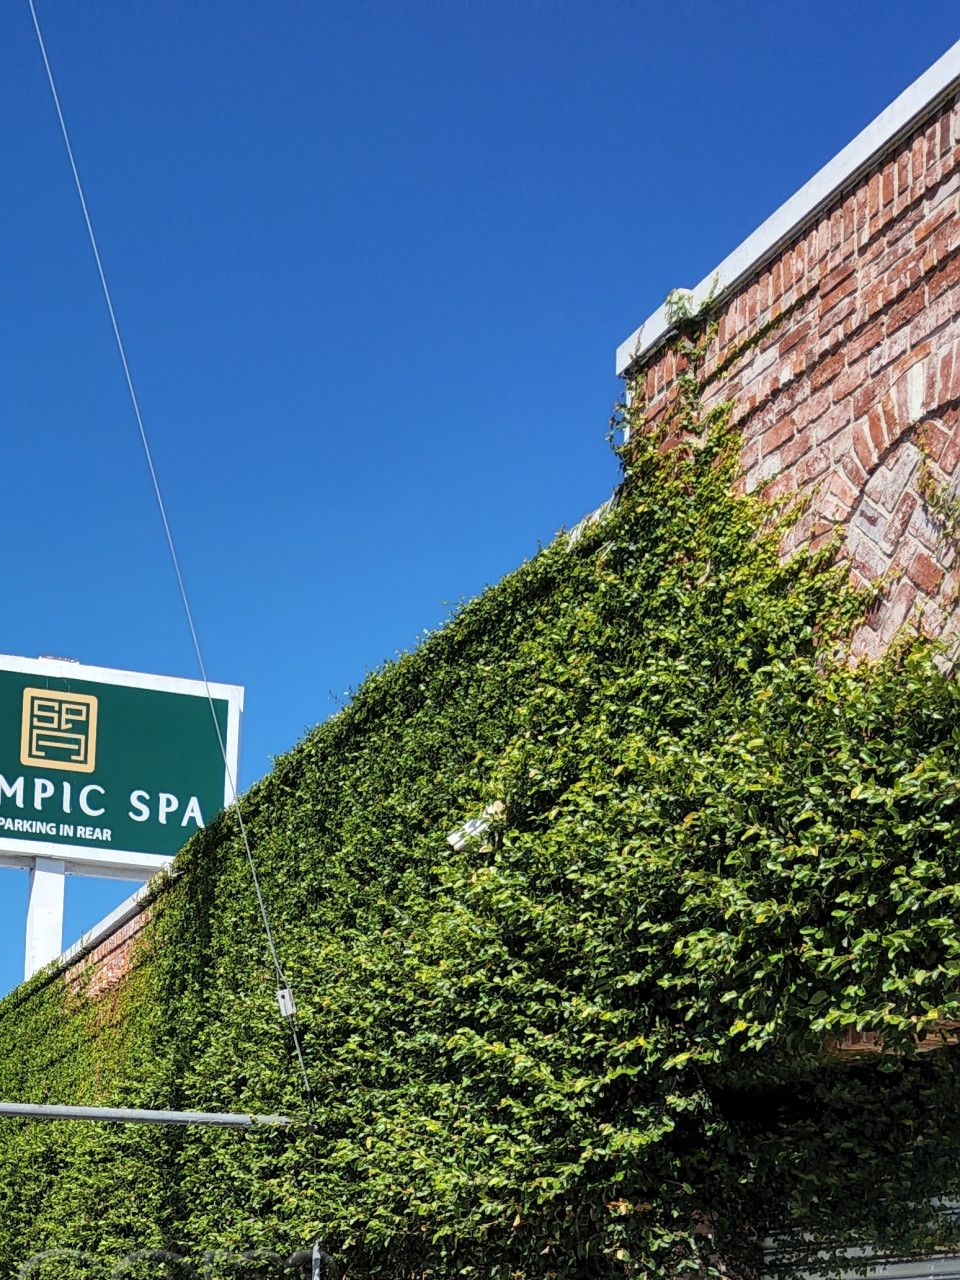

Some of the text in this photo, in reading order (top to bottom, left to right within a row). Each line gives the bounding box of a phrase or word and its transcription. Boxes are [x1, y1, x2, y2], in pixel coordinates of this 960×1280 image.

[128, 790, 205, 829] SPA
[59, 824, 75, 837] IN
[76, 826, 112, 842] REAR
